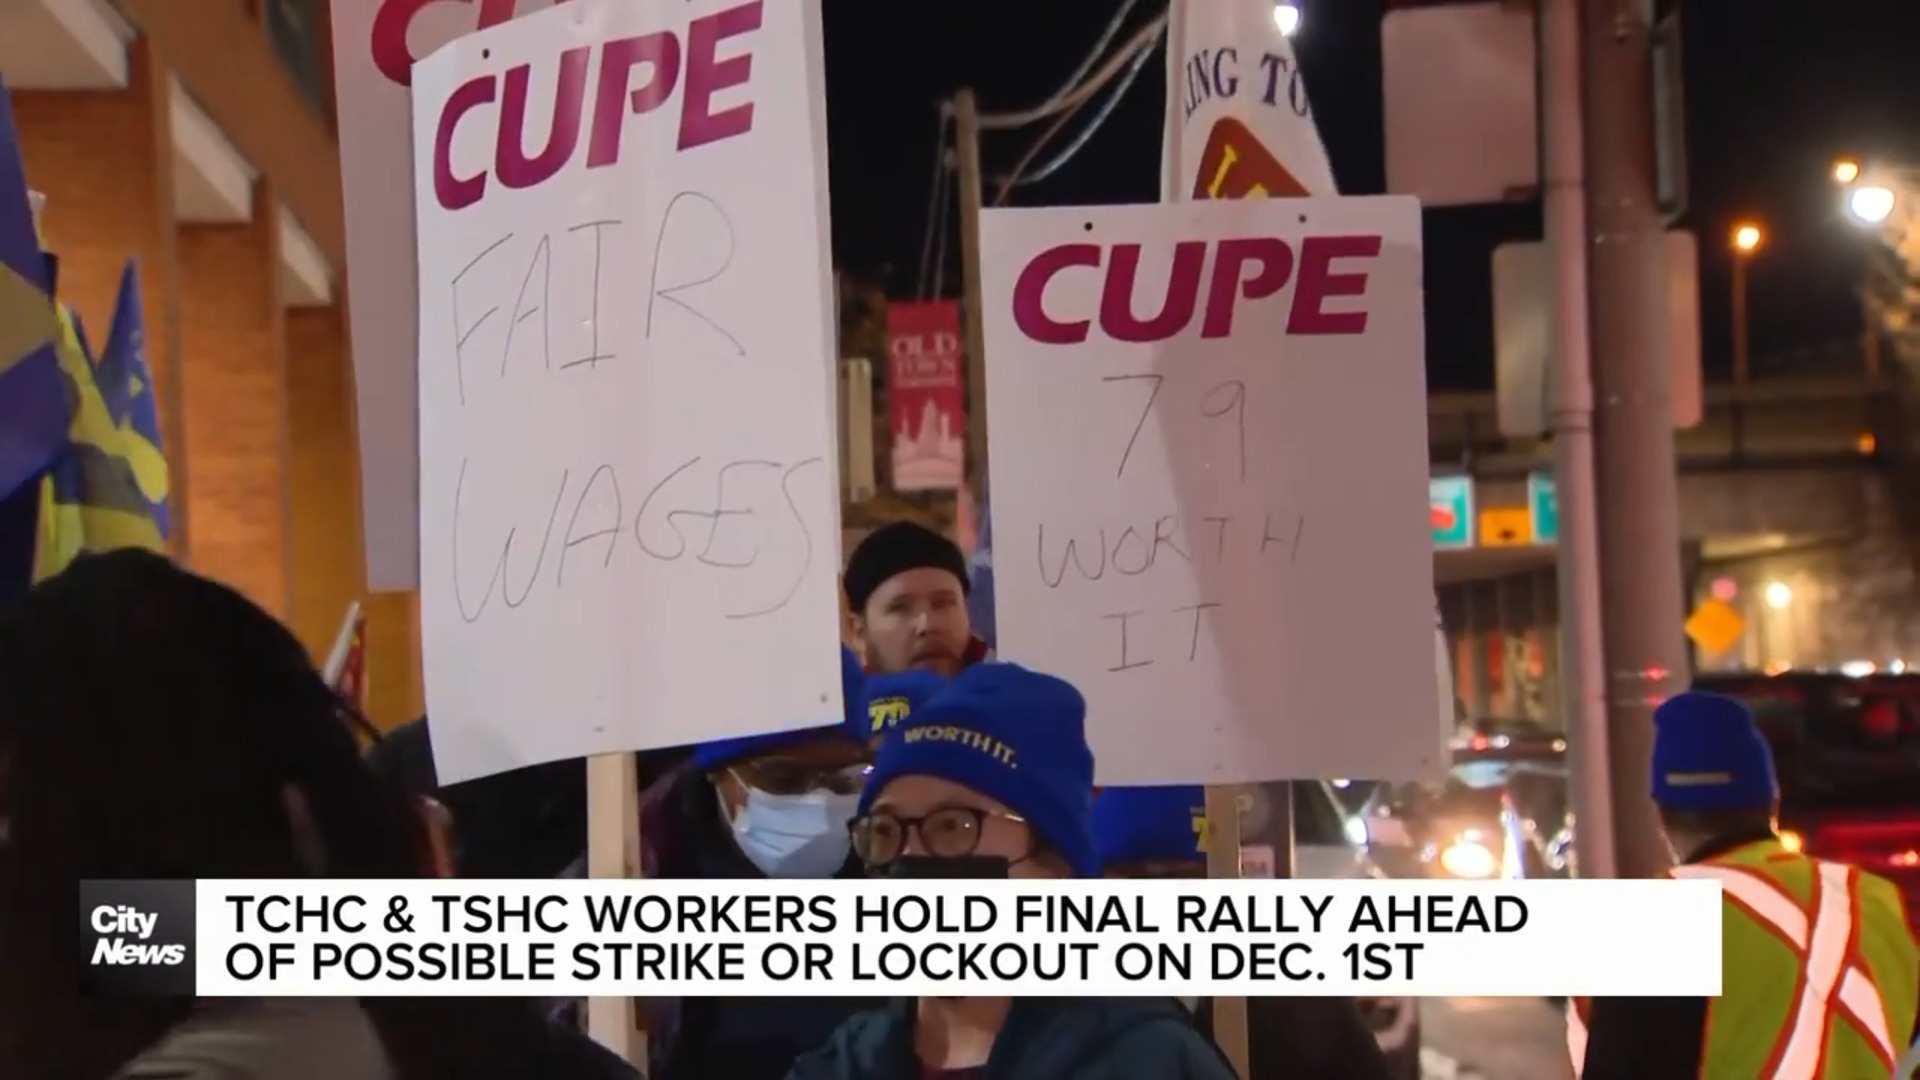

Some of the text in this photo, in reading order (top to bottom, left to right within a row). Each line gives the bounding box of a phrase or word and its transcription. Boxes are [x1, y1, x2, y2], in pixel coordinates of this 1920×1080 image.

[433, 0, 764, 211] CUPE
[451, 190, 746, 405] FAIR
[1012, 235, 1383, 345] CUPE
[1101, 373, 1245, 483] 79
[452, 455, 823, 624] WAGES
[1037, 512, 1305, 589] WORTH
[1101, 602, 1222, 672] IT
[904, 726, 1017, 769] WORTH IT.
